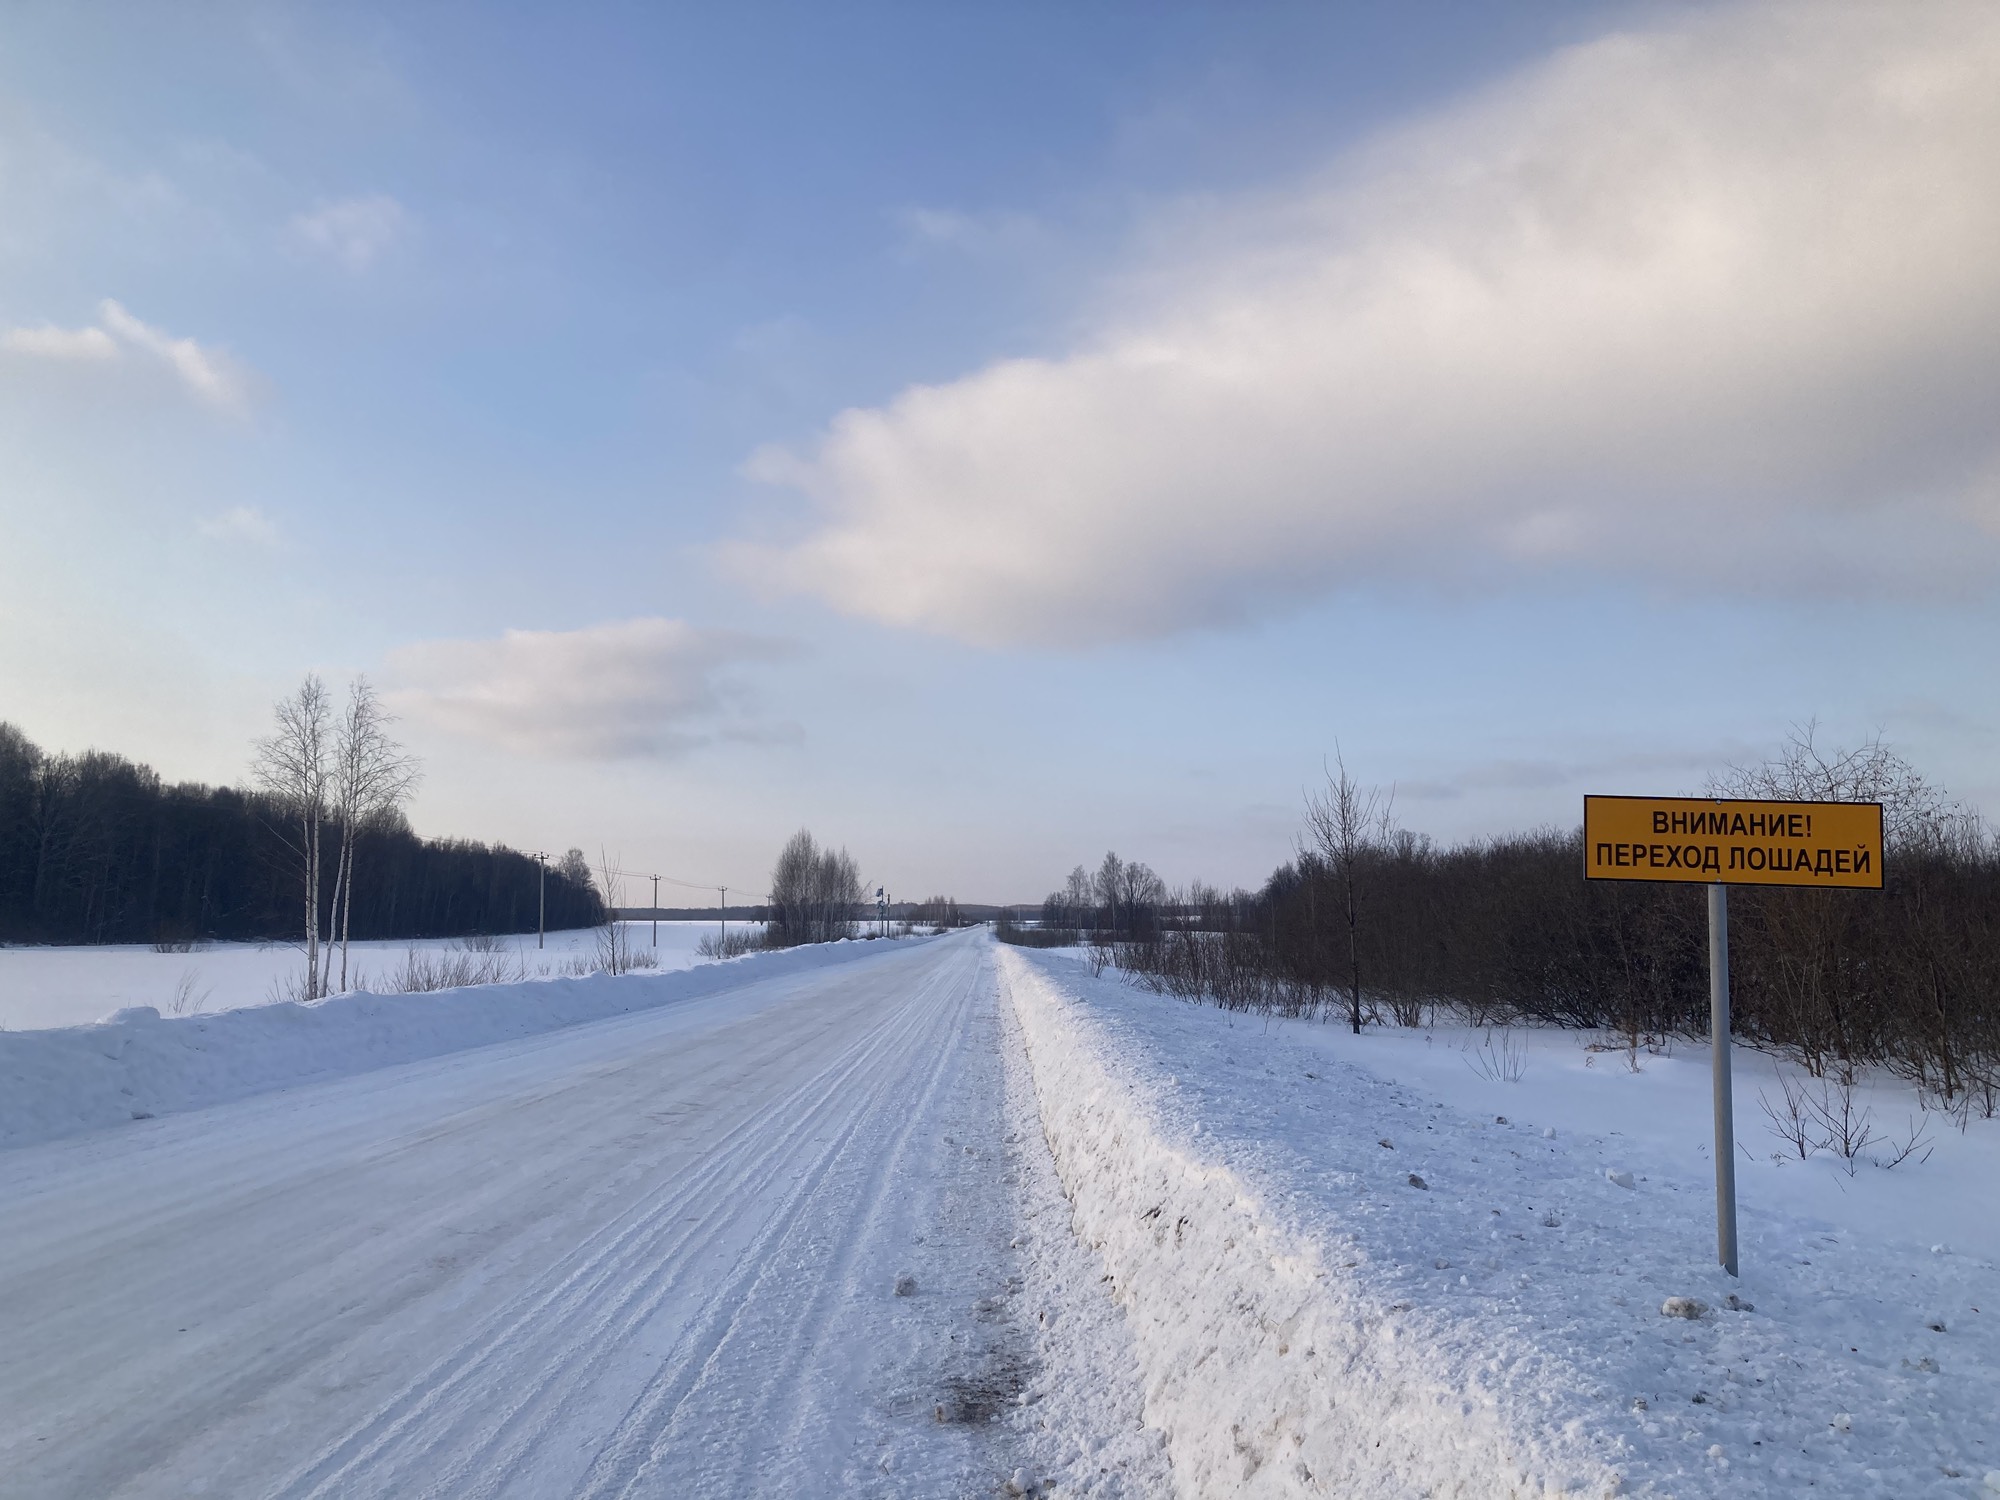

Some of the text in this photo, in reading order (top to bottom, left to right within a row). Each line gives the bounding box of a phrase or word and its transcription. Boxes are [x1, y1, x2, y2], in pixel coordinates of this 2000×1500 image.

[1653, 811, 1812, 837] ВНИМАНИЕ!
[1597, 843, 1870, 877] ПЕРЕХОД ЛОШАДЕЙ
